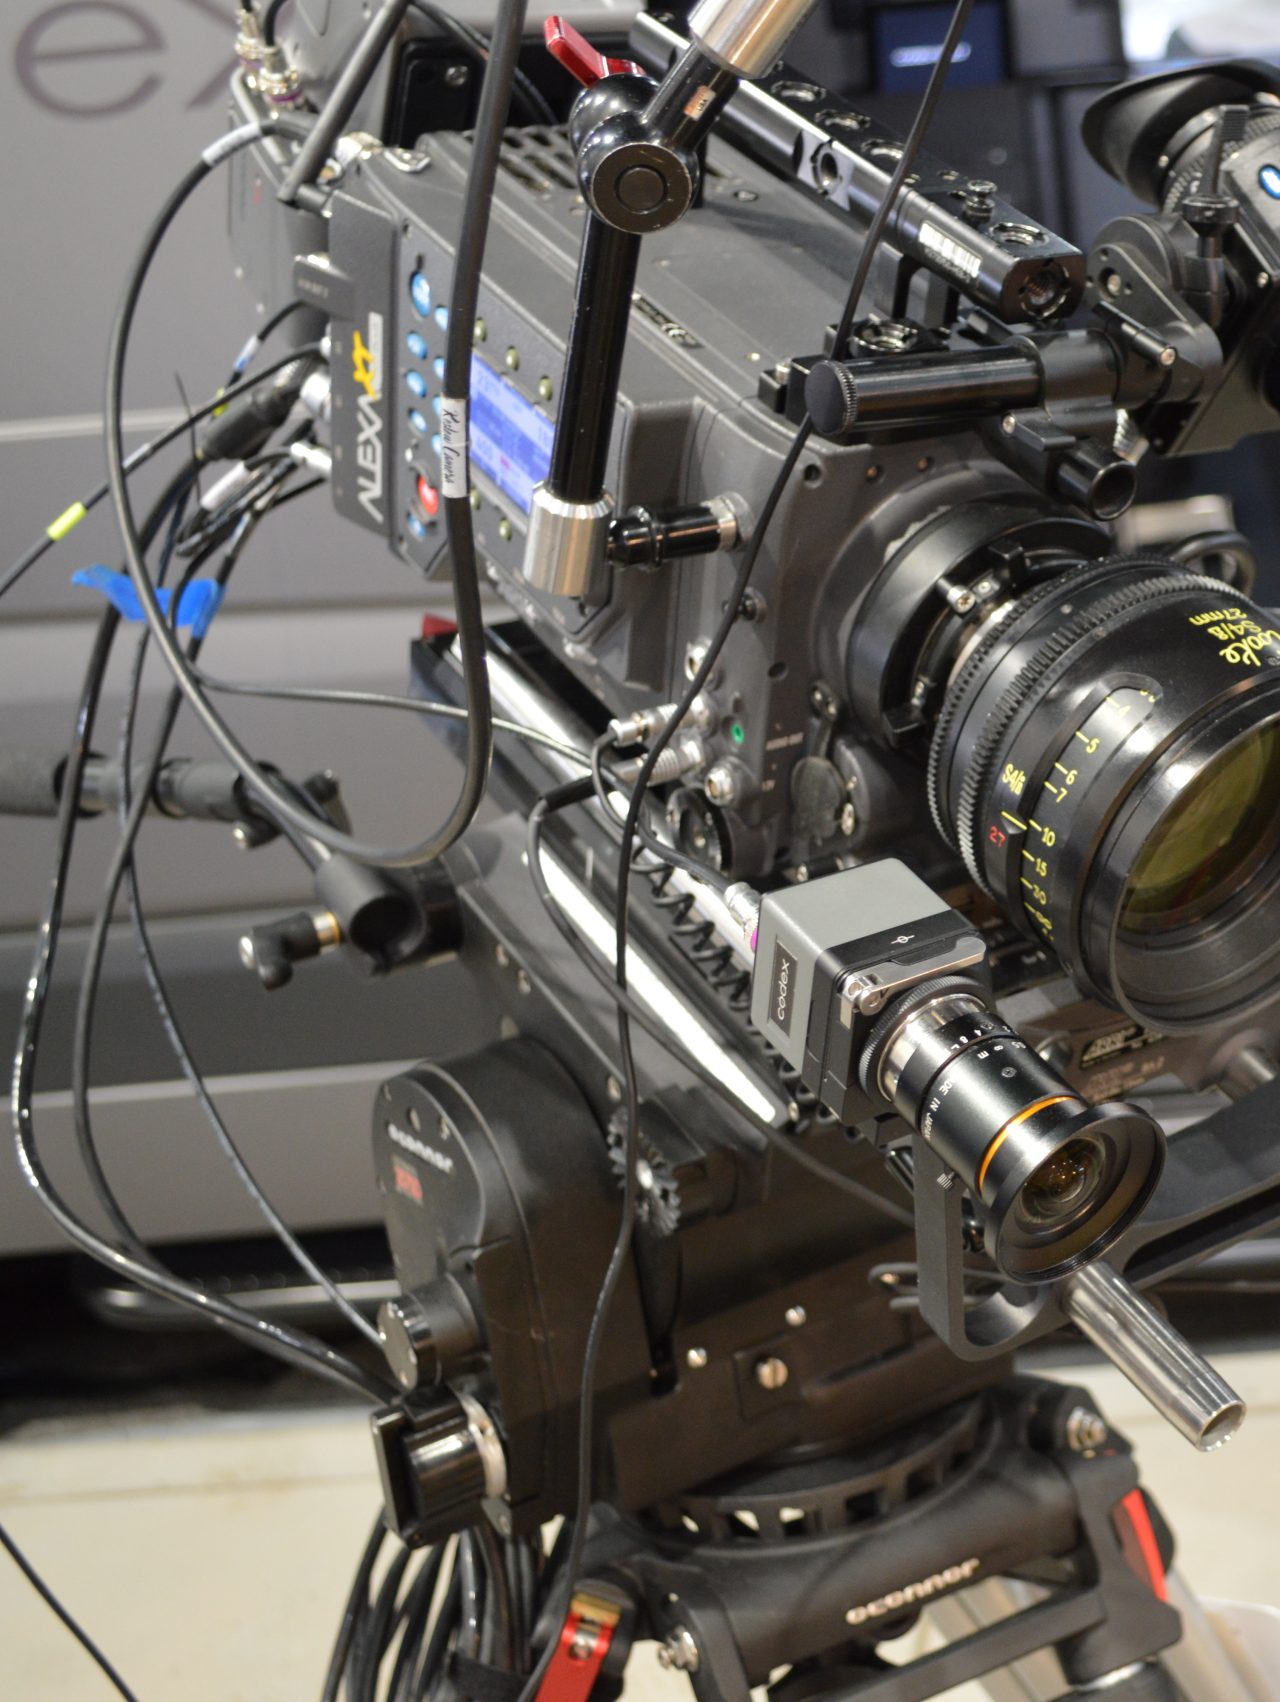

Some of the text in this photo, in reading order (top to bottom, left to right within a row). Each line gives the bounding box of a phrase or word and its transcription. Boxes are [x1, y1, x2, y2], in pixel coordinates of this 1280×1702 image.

[356, 392, 384, 525] ALEXA
[1188, 607, 1248, 626] 27mm
[1085, 737, 1100, 754] 5
[1065, 769, 1079, 786] 6
[1055, 787, 1069, 804] 7
[989, 825, 1007, 848] 27
[1041, 826, 1056, 848] 10
[1035, 857, 1048, 878] 15
[1032, 884, 1047, 906] 30
[777, 958, 791, 1021] codex
[929, 1097, 942, 1112] IN
